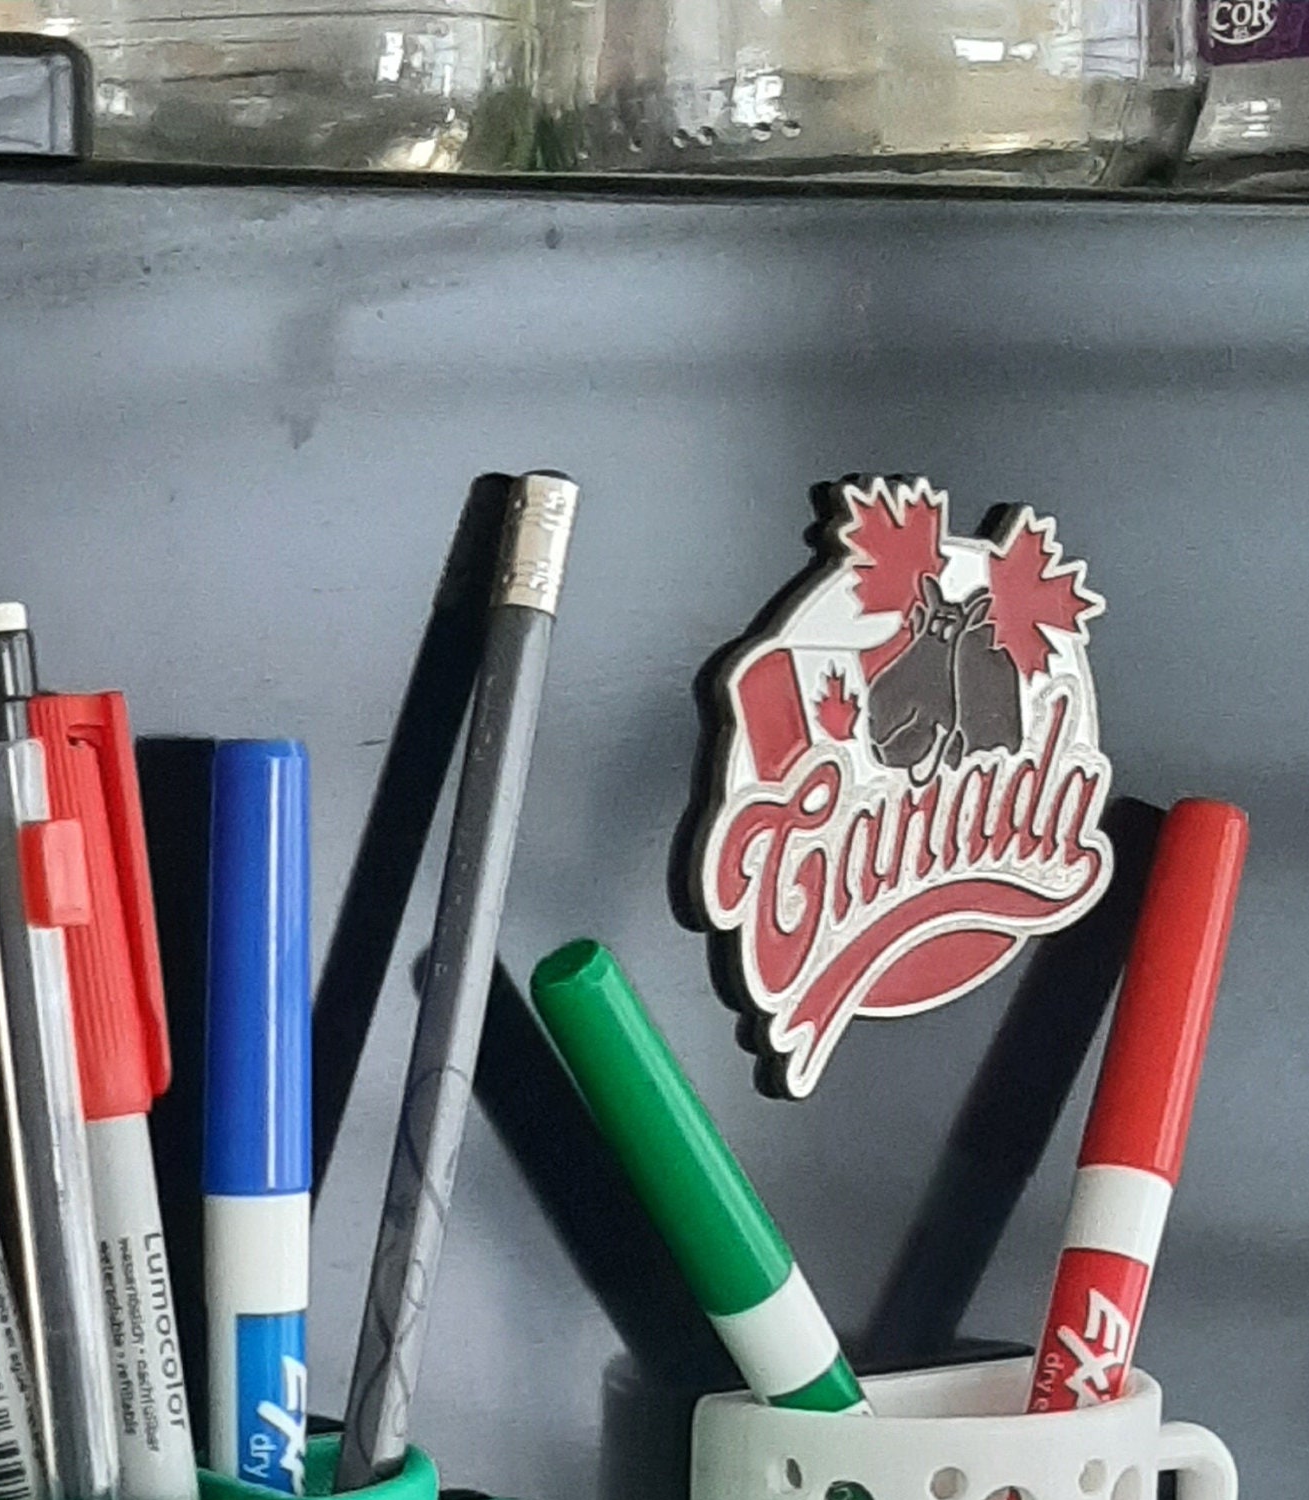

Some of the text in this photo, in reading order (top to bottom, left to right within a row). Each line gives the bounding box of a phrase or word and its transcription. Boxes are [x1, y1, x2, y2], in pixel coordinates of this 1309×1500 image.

[1209, 0, 1273, 31] COR
[710, 680, 1110, 1000] Canada
[144, 1232, 186, 1430] Lumocolor
[240, 1432, 277, 1479] dry
